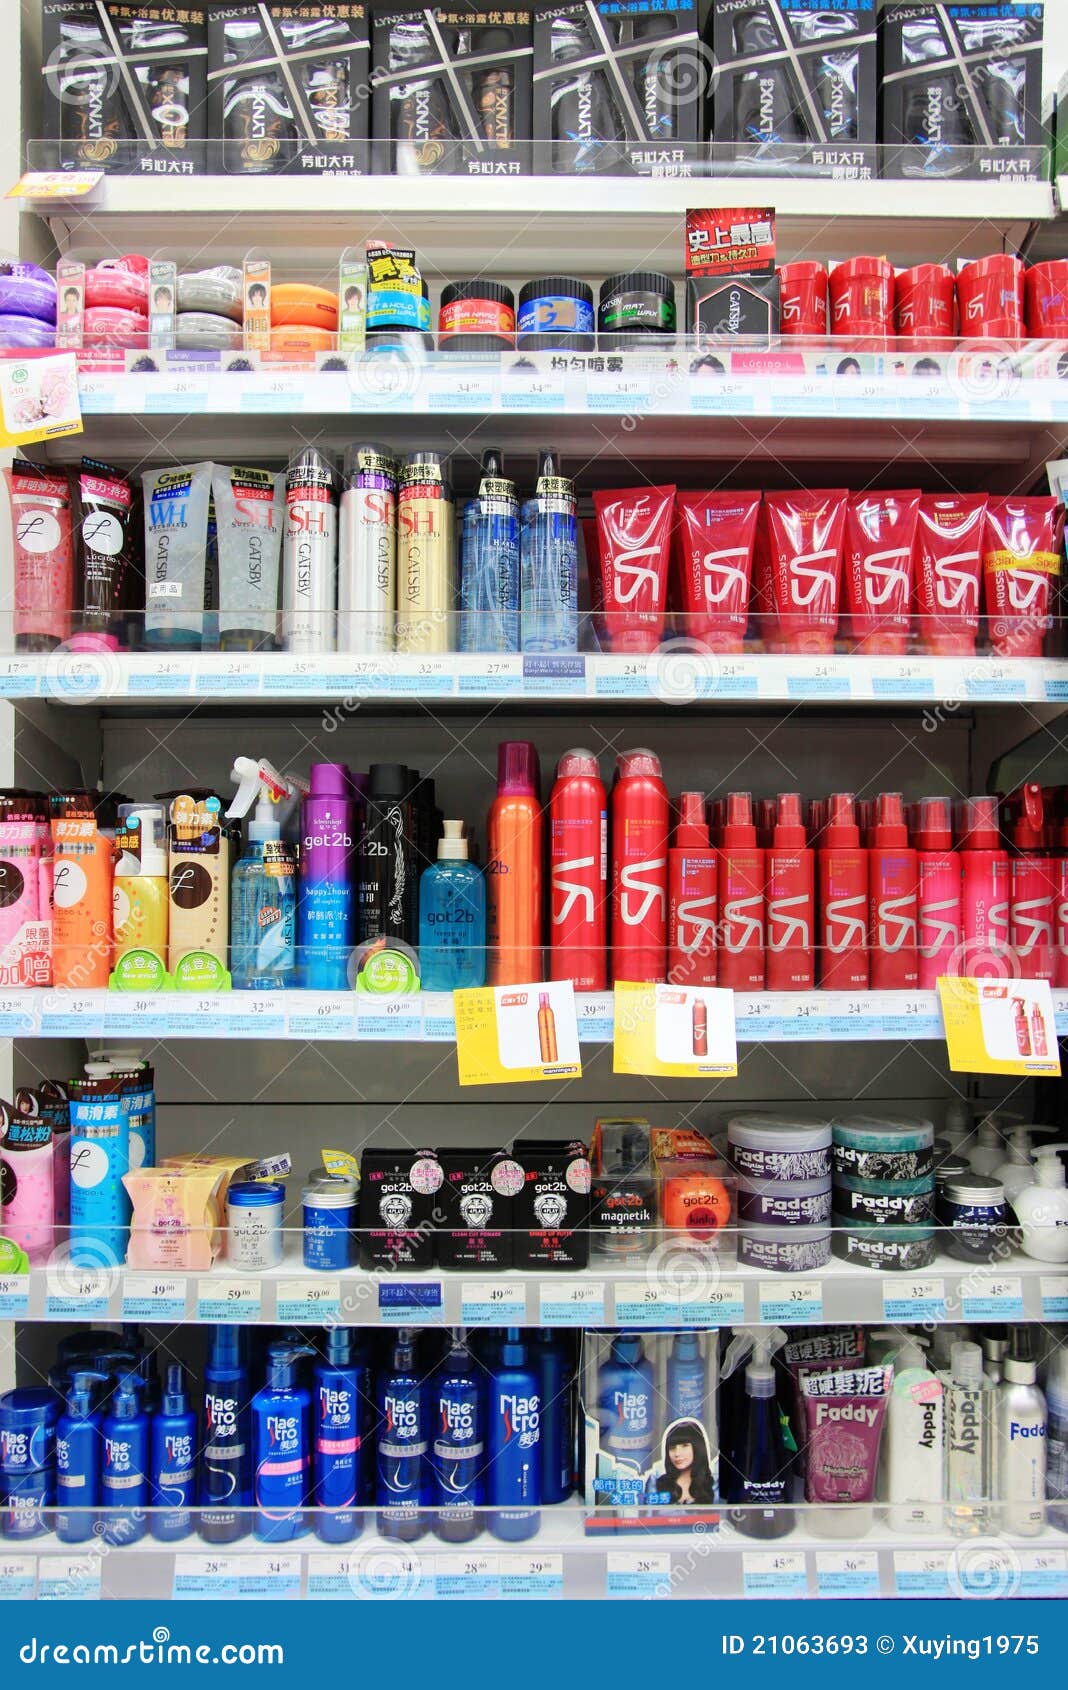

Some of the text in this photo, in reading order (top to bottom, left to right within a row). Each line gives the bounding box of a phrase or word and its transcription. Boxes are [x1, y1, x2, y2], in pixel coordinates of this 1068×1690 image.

[88, 92, 103, 139] LYNX
[252, 93, 266, 139] LYNX
[415, 96, 430, 142] LYNX
[578, 91, 592, 138] LYNX
[759, 89, 774, 133] LYNX
[141, 158, 194, 174] 芳心大开
[301, 155, 355, 169] 芳心大开
[468, 161, 521, 175] 芳心大开
[631, 150, 685, 165] 芳心大开
[812, 152, 865, 166] 芳心大开
[979, 159, 1031, 173] 芳心大开
[688, 221, 773, 252] 史上最高
[729, 290, 741, 335] GATSBY
[551, 356, 624, 373] 均匀喷雾
[288, 505, 325, 534] SH
[399, 506, 434, 538] SH
[247, 536, 262, 590] GATSBY
[297, 543, 312, 598] GATSBY
[376, 536, 390, 596] GATSBY
[406, 546, 421, 605] GATSBY
[691, 550, 702, 602] SASSOON
[778, 554, 789, 606] SASSOON
[852, 552, 862, 605] SASSOON
[922, 556, 934, 609] SASSOON
[304, 832, 352, 850] got2b
[427, 909, 475, 924] got2b
[381, 1182, 414, 1194] got2b
[461, 1182, 494, 1194] got2b
[535, 1182, 568, 1193] got2b
[683, 1195, 719, 1207] got2b
[851, 1193, 917, 1213] Faddy
[601, 1209, 651, 1225] magnetik
[847, 1236, 911, 1260] Faddy
[806, 1369, 884, 1396] 超硬髮泥
[815, 1402, 879, 1428] Faddy
[918, 1402, 937, 1449] Faddy
[744, 1479, 786, 1489] Faddy
